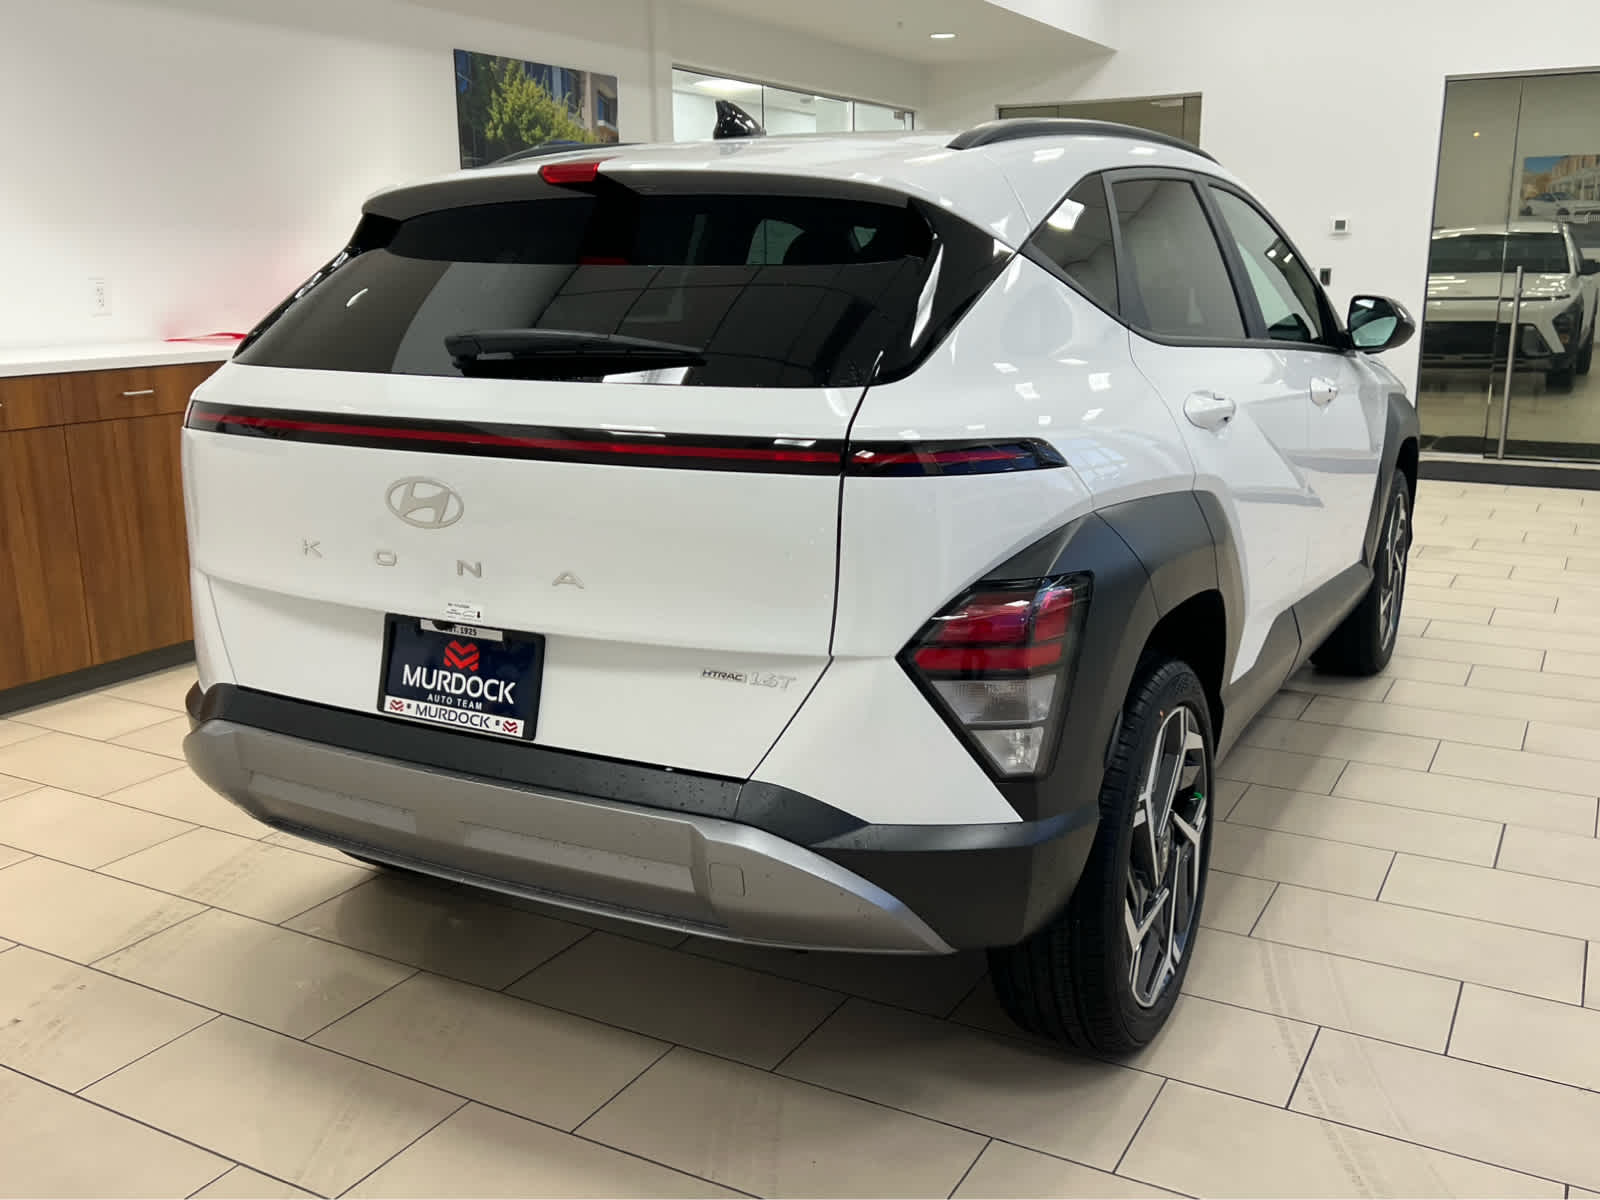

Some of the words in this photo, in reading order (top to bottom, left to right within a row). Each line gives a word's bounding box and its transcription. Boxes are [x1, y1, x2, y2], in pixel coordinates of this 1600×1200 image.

[402, 664, 516, 705] MURDOCK
[702, 670, 744, 682] HTRAC
[427, 694, 453, 704] AUTO
[457, 699, 483, 711] TEAM
[415, 704, 490, 729] MURDOCK
